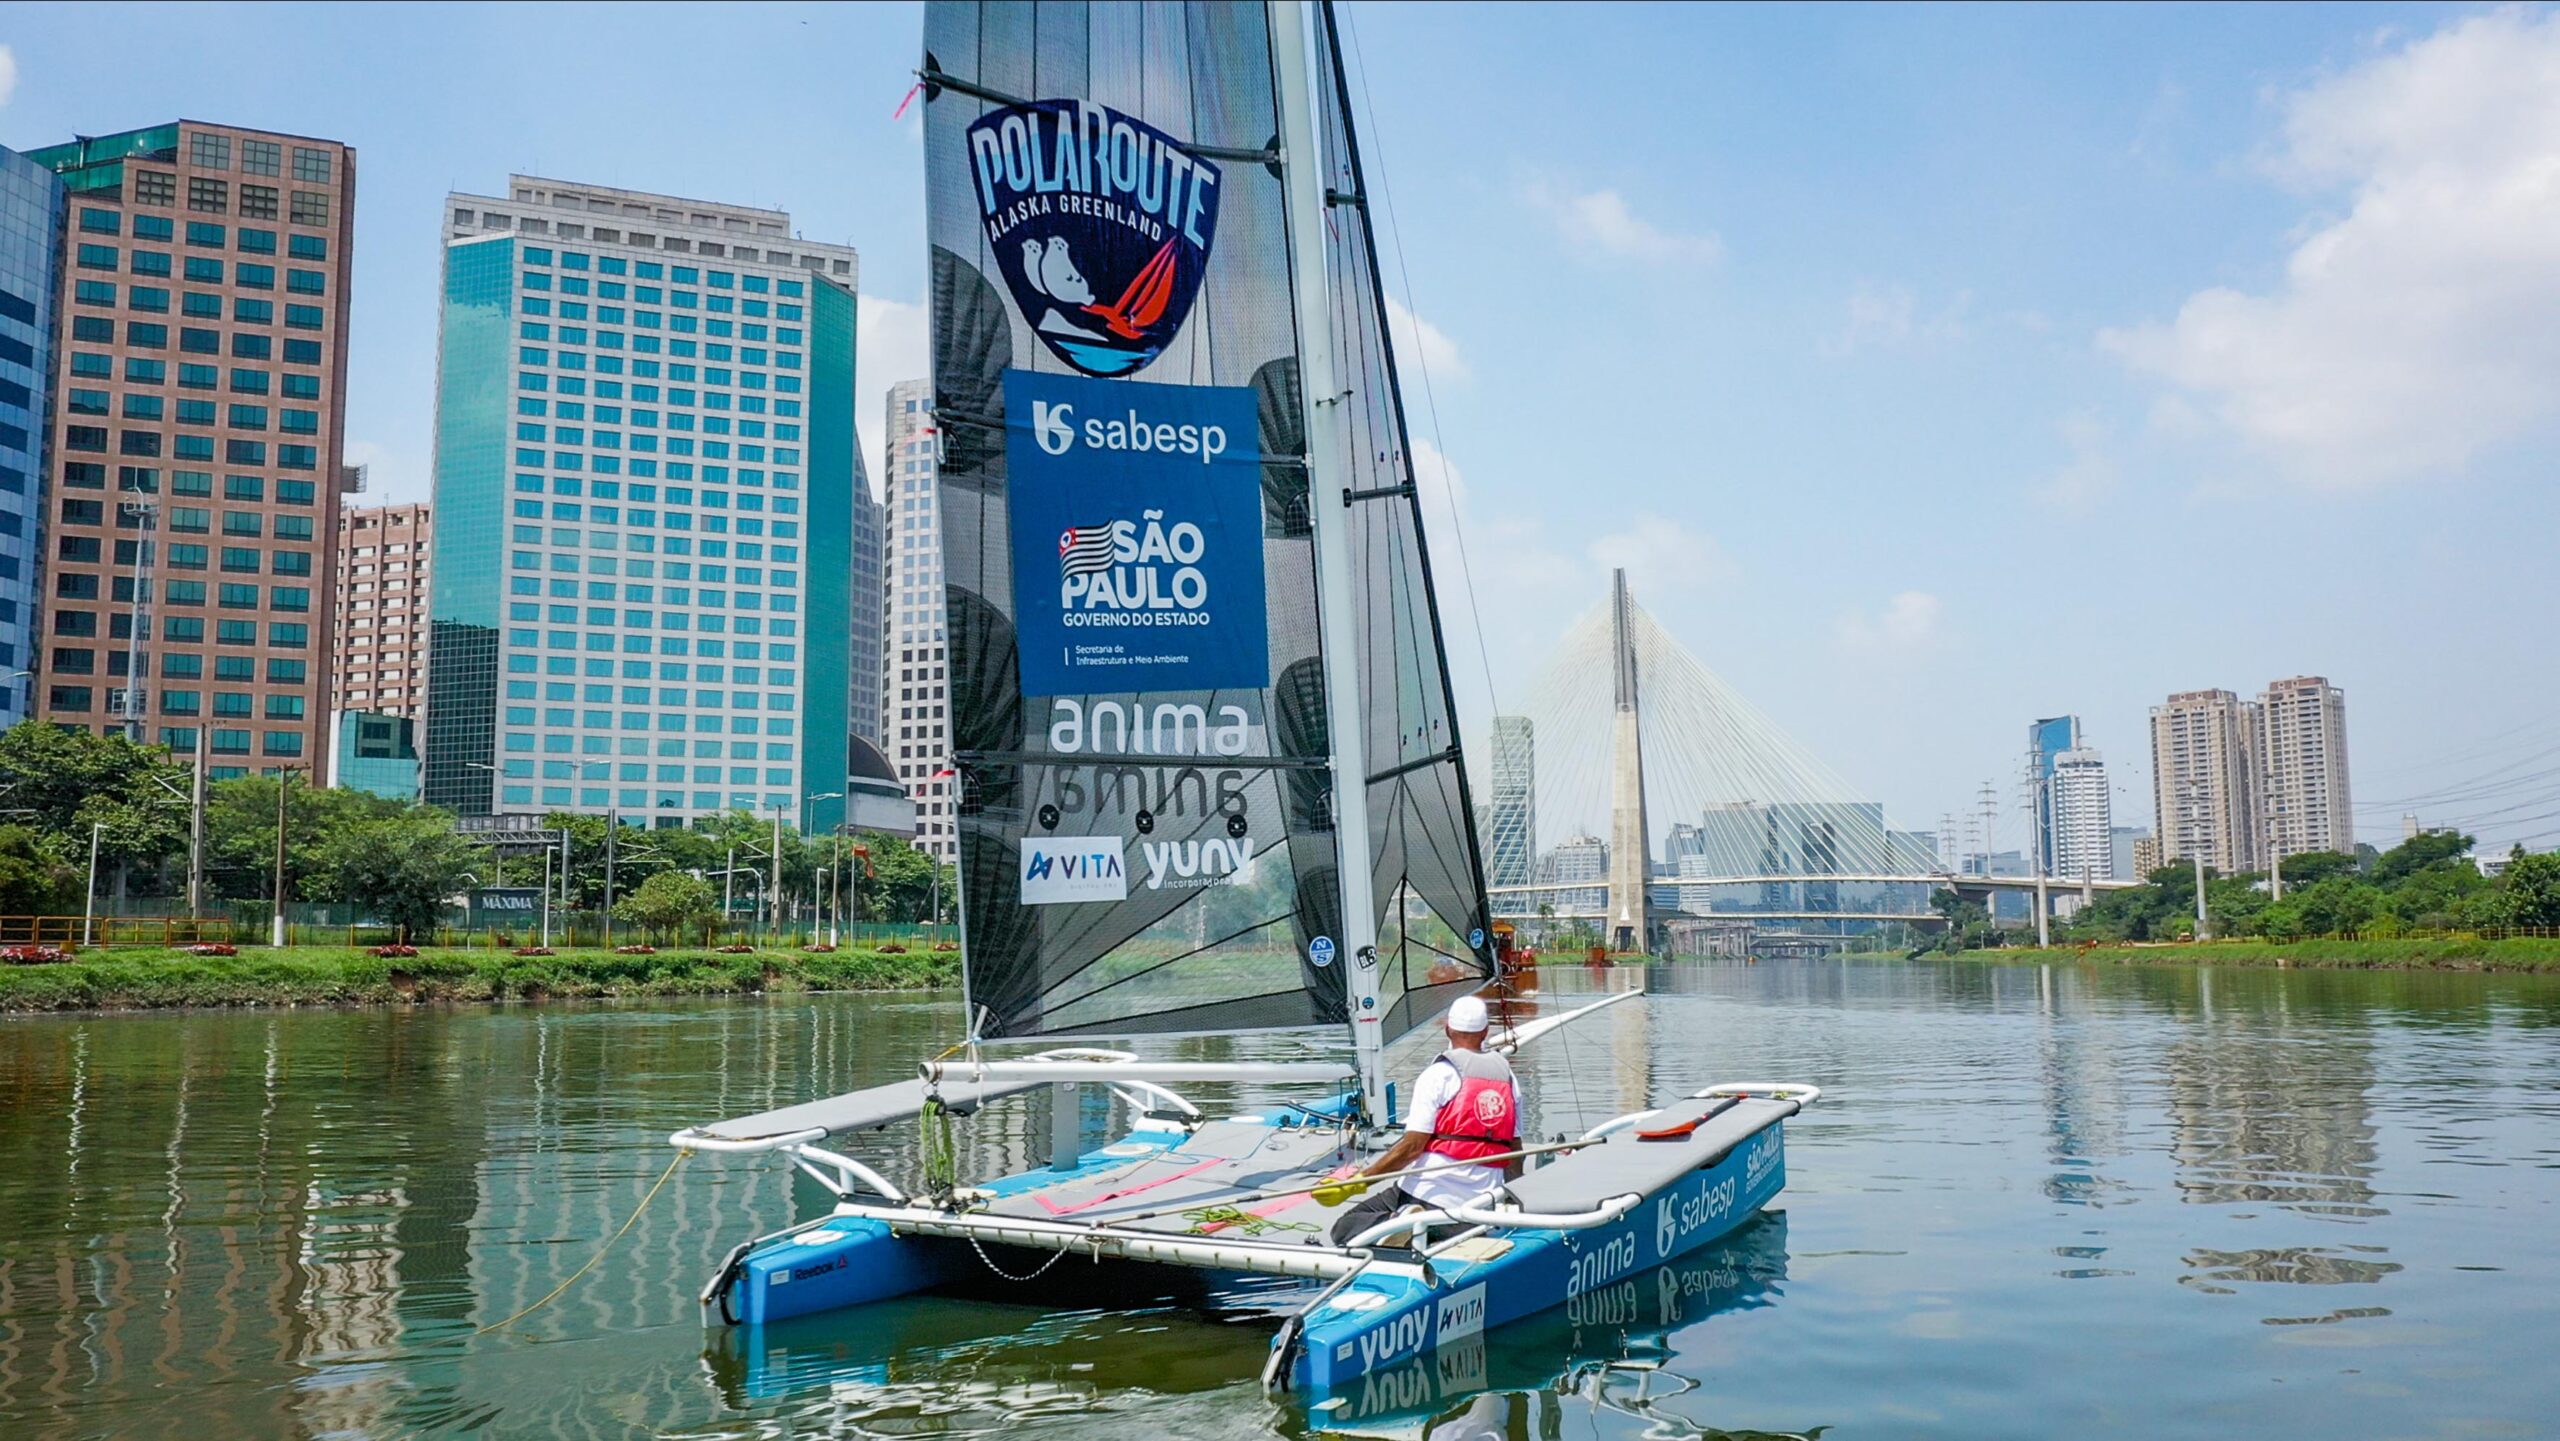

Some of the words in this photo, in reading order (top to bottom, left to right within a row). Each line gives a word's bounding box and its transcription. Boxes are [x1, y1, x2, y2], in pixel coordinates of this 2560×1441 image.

[972, 100, 1215, 250] POLAROUTE
[990, 194, 1051, 242] ALASKA
[1059, 194, 1162, 242] GREENLAND
[1084, 409, 1227, 464] sabesp
[1112, 509, 1205, 564] SÃO
[1061, 567, 1208, 609] PAULO
[1063, 613, 1130, 627] GOVERNO
[1132, 613, 1153, 626] DO
[1155, 612, 1210, 626] ESTADO
[1075, 645, 1112, 654] Secretaria
[1114, 645, 1124, 653] de
[1076, 656, 1127, 666] Infraestrutura
[1135, 656, 1152, 664] Meio
[1154, 655, 1189, 664] Ambiente
[1060, 854, 1121, 879] VITA
[1142, 838, 1254, 890] yuny
[1680, 1176, 1734, 1235] sabesp
[1456, 1297, 1483, 1325] VITA
[1360, 1305, 1430, 1375] yuny
